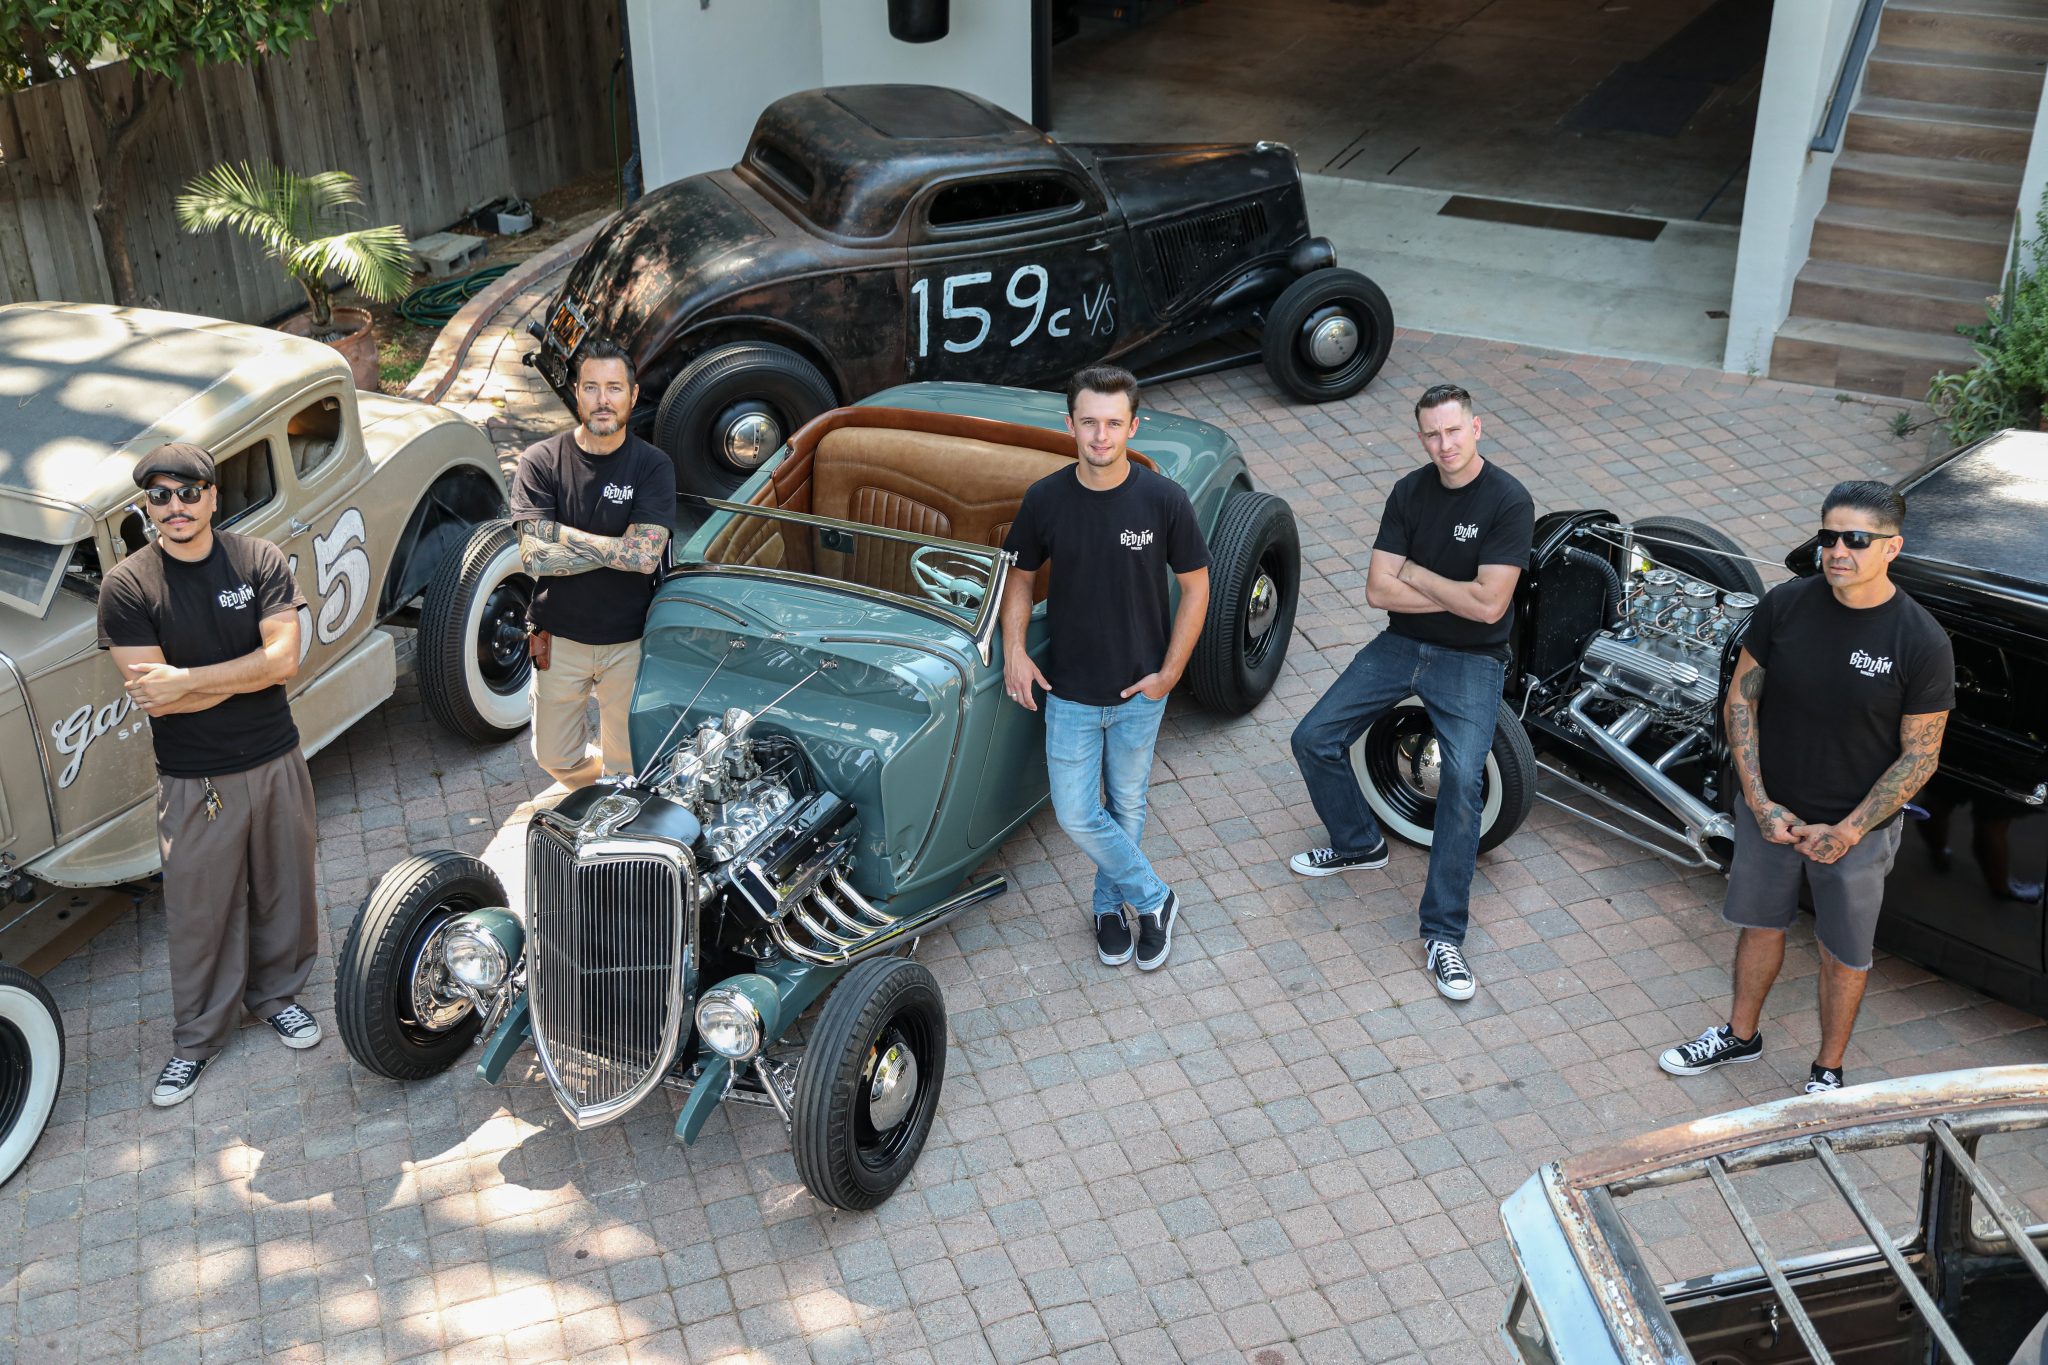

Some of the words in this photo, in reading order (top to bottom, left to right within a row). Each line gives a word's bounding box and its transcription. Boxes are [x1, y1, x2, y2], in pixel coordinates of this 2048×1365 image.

[1120, 529, 1154, 547] BEDLAM
[1453, 522, 1479, 539] EDLAM
[218, 584, 255, 608] BEDLAM
[287, 505, 371, 664] 5
[1849, 649, 1893, 674] BEDLAM
